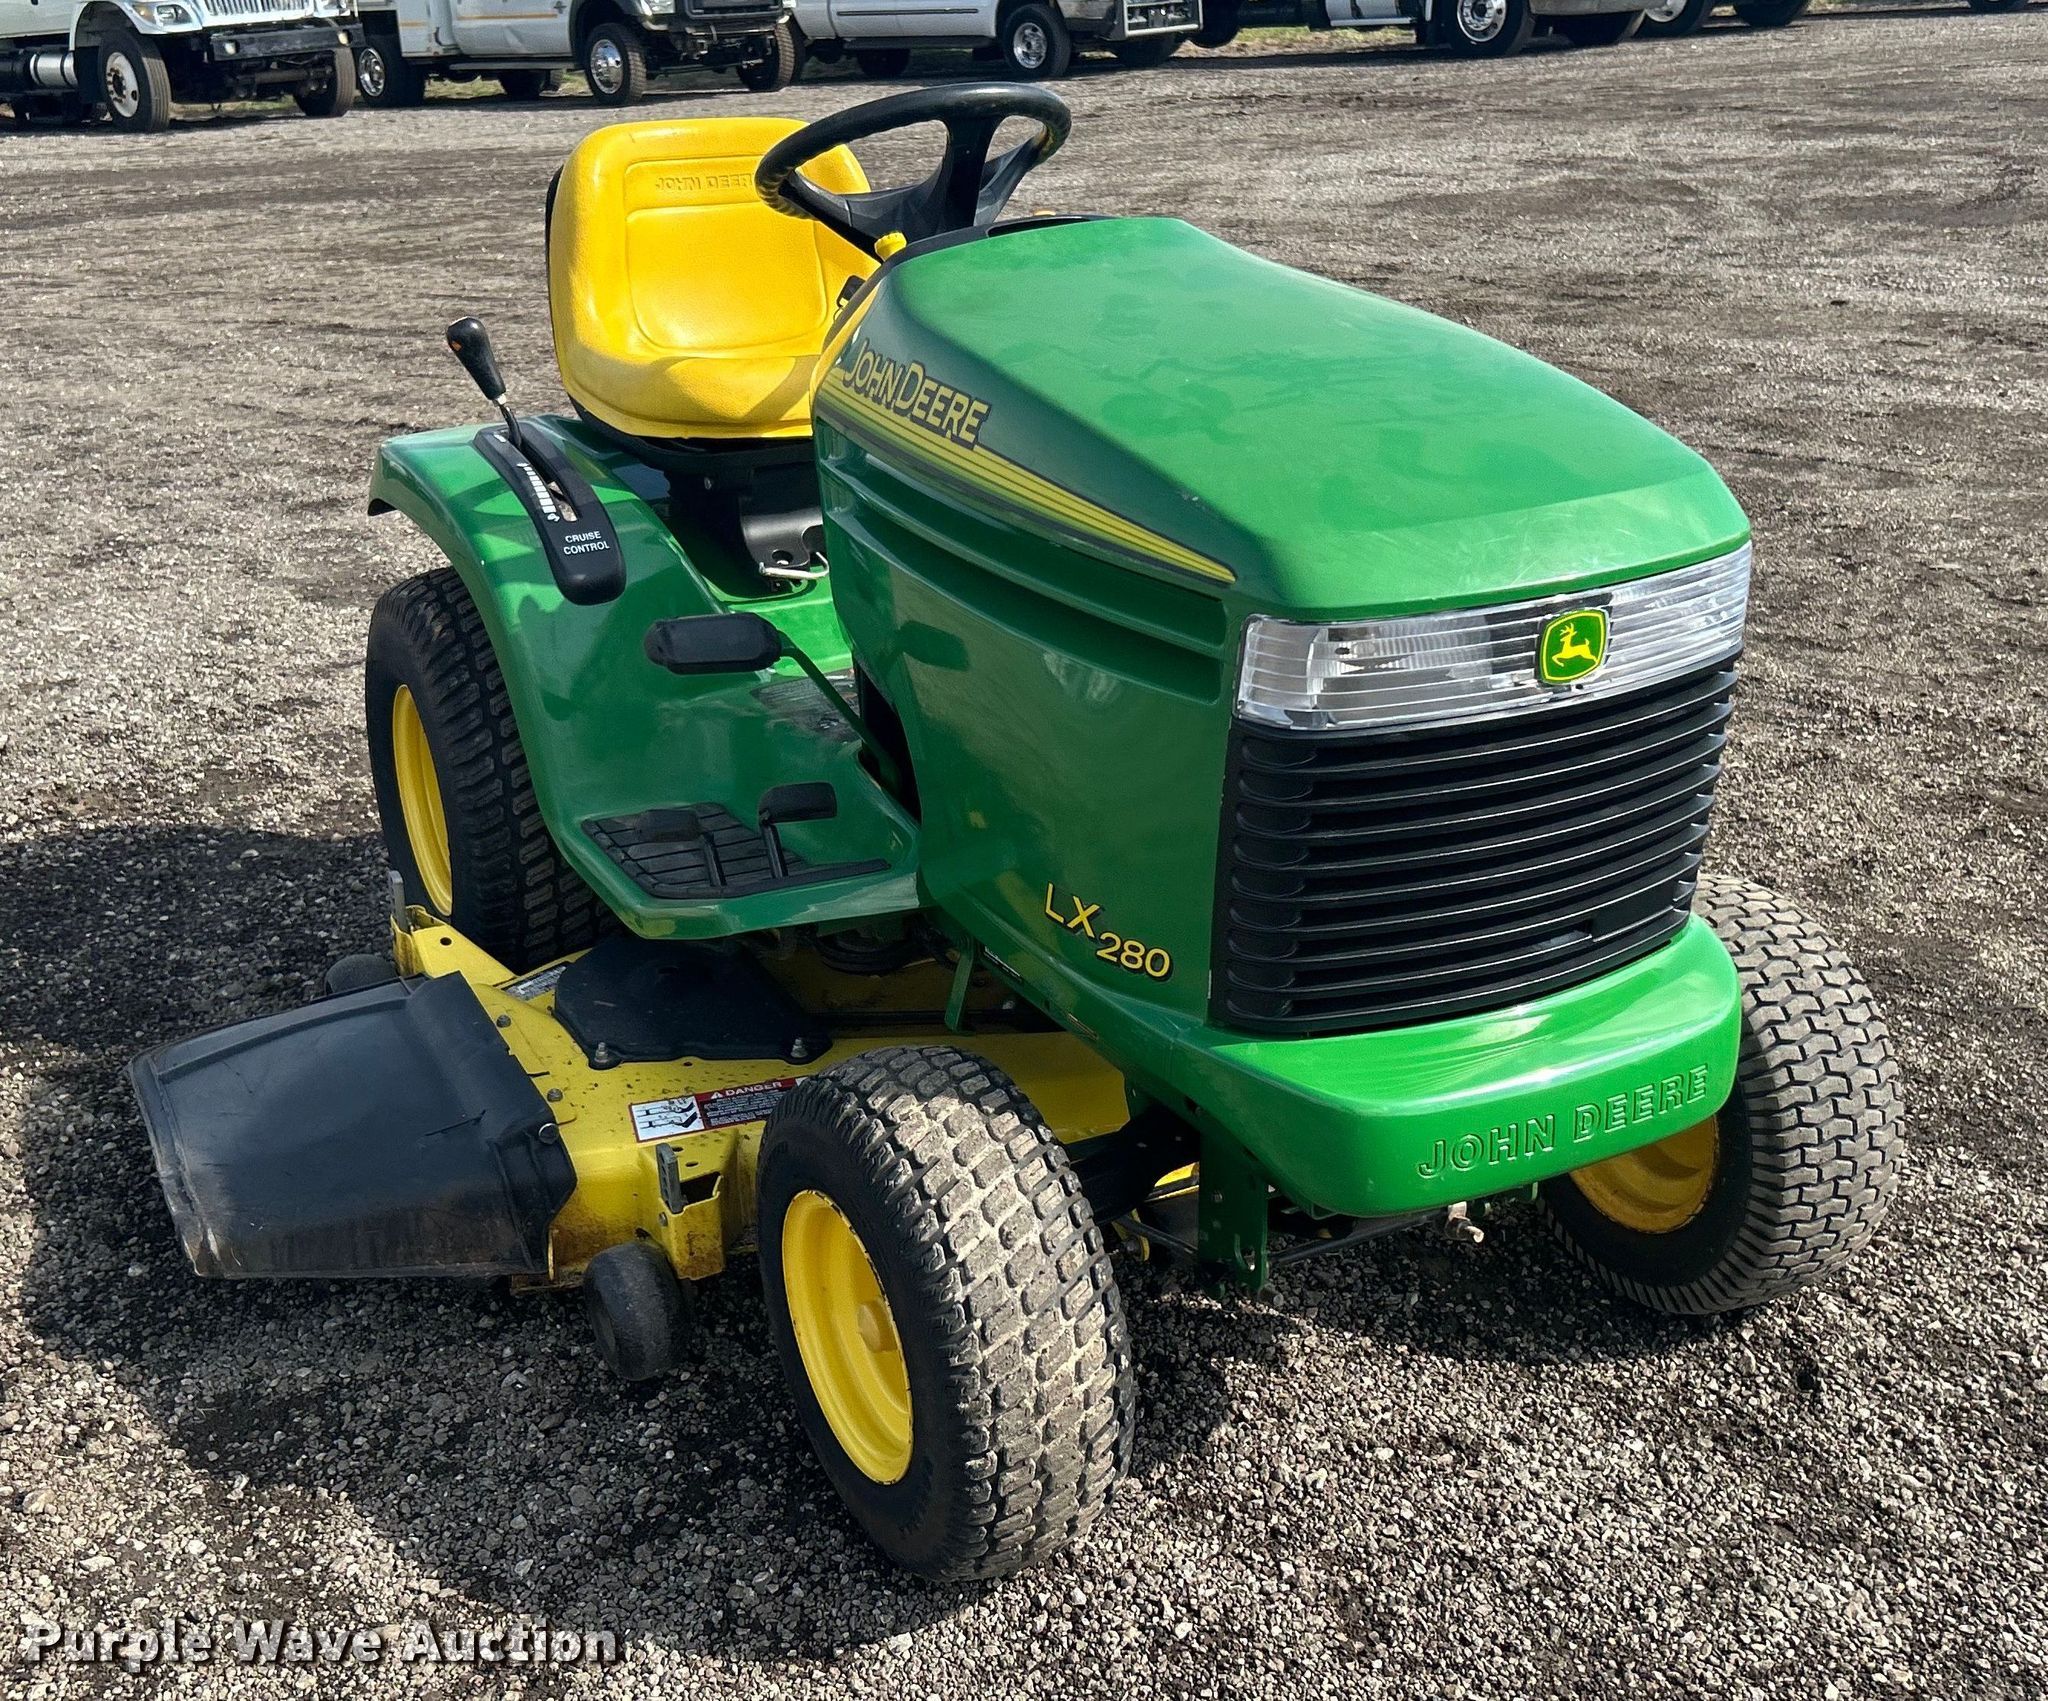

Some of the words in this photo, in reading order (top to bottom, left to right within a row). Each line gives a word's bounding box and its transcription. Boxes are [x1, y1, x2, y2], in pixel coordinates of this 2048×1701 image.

[655, 176, 702, 191] JOHN
[705, 172, 755, 189] DEER
[843, 338, 905, 410] JOHN
[892, 361, 990, 447] DEERE
[564, 530, 602, 543] CRUISE
[563, 540, 611, 555] CONTROL
[725, 1081, 783, 1097] DANGER
[1417, 1113, 1556, 1179] JOHN
[1573, 1062, 1709, 1144] DEERE
